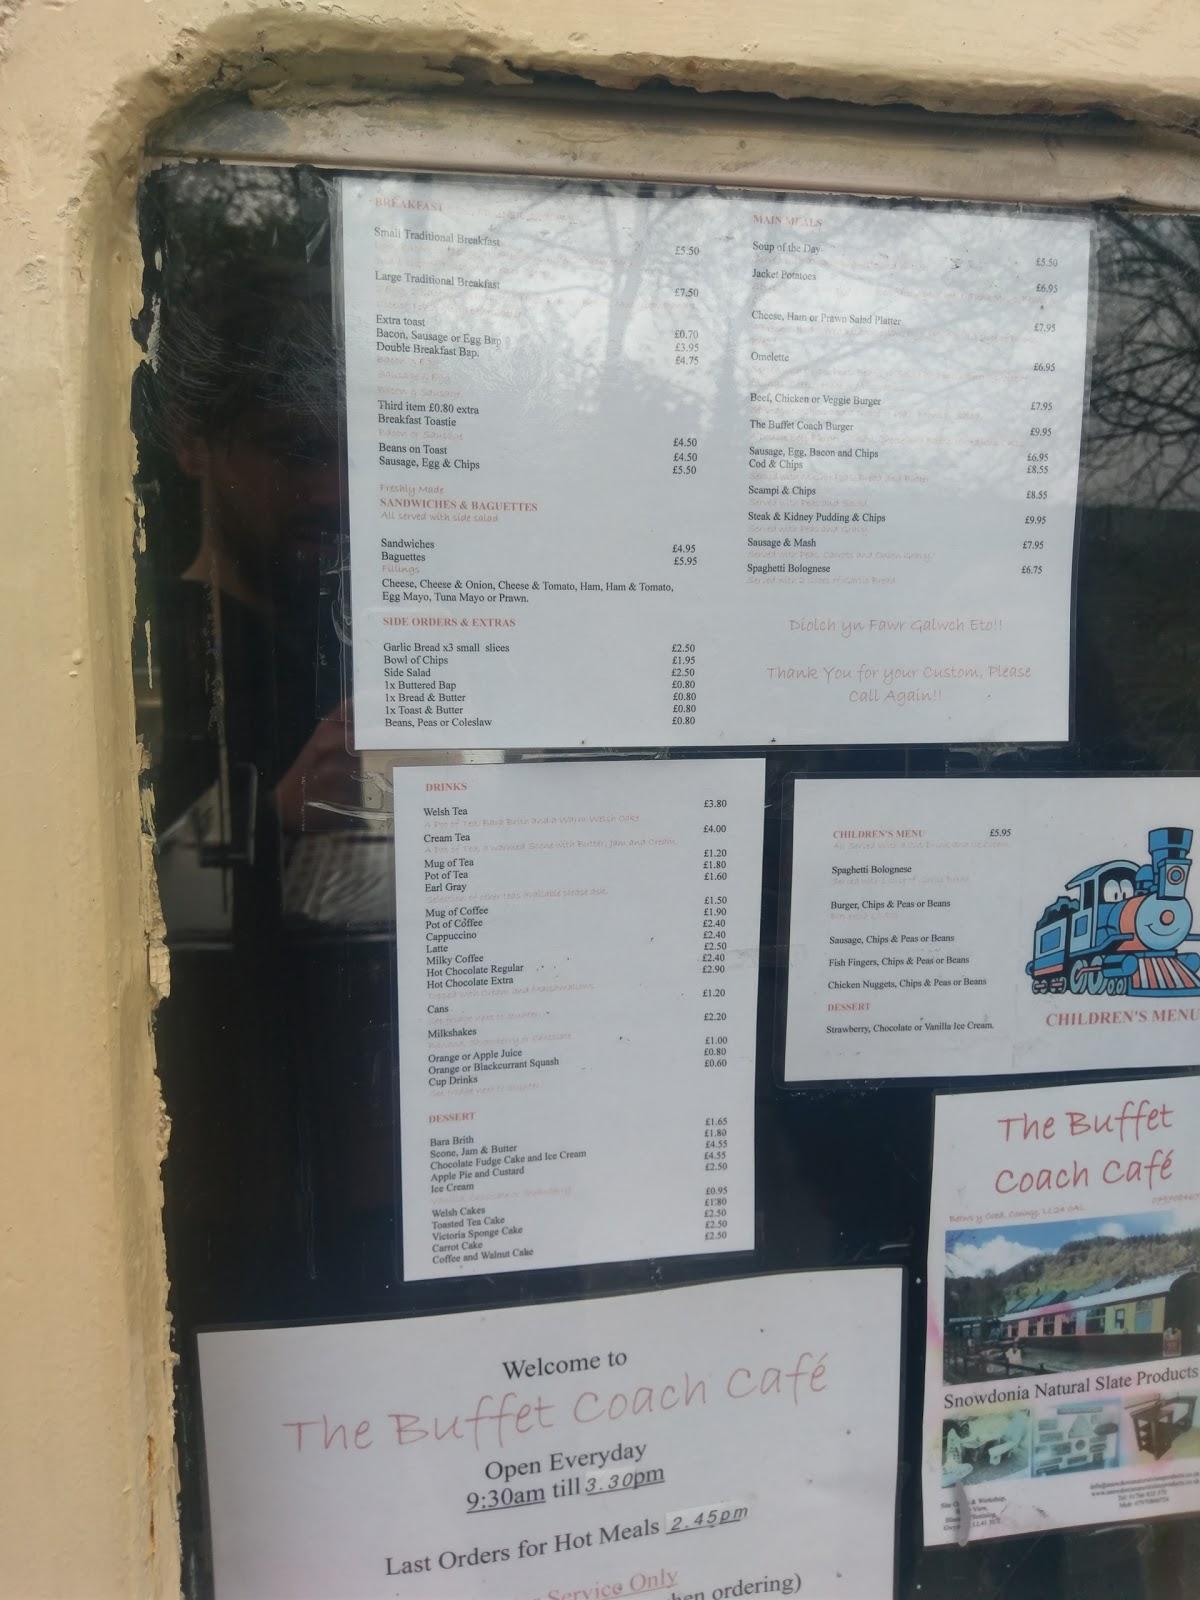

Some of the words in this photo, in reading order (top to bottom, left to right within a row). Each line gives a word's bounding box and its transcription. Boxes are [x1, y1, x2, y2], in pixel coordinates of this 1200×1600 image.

[752, 214, 783, 226] MAIN
[374, 226, 401, 239] Small
[404, 229, 455, 243] Traditional
[457, 233, 501, 247] Breakfast
[674, 245, 700, 257] £5.50
[751, 268, 779, 280] Jacket
[781, 270, 817, 281] Potatoes
[1035, 283, 1059, 294] £6.95
[751, 351, 790, 363] Omelette
[1033, 362, 1056, 373] £6.95
[377, 400, 403, 412] Third
[405, 402, 427, 414] item
[429, 402, 454, 414] £0.80
[456, 406, 479, 415] extra
[378, 414, 422, 426] Breakfast
[423, 416, 457, 427] Toastie
[750, 420, 767, 430] The
[768, 420, 795, 430] Buffet
[797, 420, 824, 431] Coach
[825, 421, 854, 432] Burger
[1029, 427, 1052, 438] £9.95
[673, 437, 698, 448] £4.50
[380, 498, 457, 512] SANDWICHES
[459, 500, 468, 511] &
[471, 500, 538, 512] BAGUETTES
[380, 511, 395, 521] All
[397, 512, 427, 521] served
[429, 512, 450, 522] with
[452, 513, 471, 523] side
[474, 513, 498, 523] salad
[748, 511, 771, 522] Steak
[772, 512, 782, 522] &
[783, 512, 814, 525] Kidney
[815, 512, 849, 525] Pudding
[851, 513, 860, 523] &
[862, 512, 886, 525] Chips
[1024, 515, 1047, 526] £9.95
[380, 538, 435, 550] Sandwiches
[672, 544, 696, 554] £4.95
[381, 551, 426, 563] Baguettes
[674, 557, 698, 567] £5.95
[382, 565, 420, 576] Fillings
[747, 563, 786, 576] Spaghetti
[788, 563, 831, 575] Bolognese
[1021, 565, 1043, 575] £6.75
[383, 617, 409, 627] SIDE
[411, 617, 458, 627] ORDERS
[460, 617, 469, 627] &
[471, 617, 516, 628] EXTRAS
[789, 619, 836, 632] Diolch
[841, 622, 865, 638] yn
[869, 620, 905, 632] Fawr
[910, 619, 965, 633] Galwch
[970, 618, 1003, 632] Eto!!
[383, 642, 412, 653] Garlic
[413, 642, 441, 653] Bread
[443, 643, 455, 653] x3
[456, 642, 480, 653] small
[485, 643, 510, 653] slices
[671, 644, 696, 653] £2.50
[383, 667, 405, 678] Side
[406, 667, 431, 678] Salad
[671, 668, 696, 678] £2.50
[766, 666, 819, 680] Thank
[823, 666, 852, 682] You
[858, 663, 878, 682] for
[883, 667, 916, 685] your
[923, 666, 984, 681] Custom,
[988, 665, 1032, 679] Please
[848, 689, 880, 704] Call
[884, 689, 943, 707] Again!!
[385, 718, 416, 729] Beans,
[417, 718, 438, 728] Peas
[451, 718, 493, 728] Coleslaw
[671, 716, 696, 726] £0.80
[425, 782, 468, 792] DRINKS
[703, 799, 727, 809] £3.80
[423, 807, 453, 817] Welsh
[453, 806, 468, 816] Tea
[833, 829, 894, 839] CHILDREN'S
[896, 828, 926, 838] MENU
[989, 827, 1012, 838] £5.95
[831, 864, 869, 876] Spaghetti
[870, 864, 912, 875] Bolognese
[704, 871, 728, 882] £1.60
[425, 882, 443, 893] Earl
[445, 882, 467, 894] Gray
[830, 899, 860, 911] Burger,
[861, 899, 885, 911] Chips
[887, 899, 894, 909] &
[896, 899, 914, 909] Peas
[916, 901, 926, 909] or
[927, 898, 951, 908] Beans
[425, 931, 477, 943] Cappuccino
[425, 944, 449, 954] Latte
[426, 955, 453, 967] Milky
[454, 953, 484, 965] Coffee
[426, 968, 444, 978] Hot
[445, 965, 489, 977] Chocolate
[490, 963, 524, 976] Regular
[702, 964, 725, 975] £2.90
[427, 1004, 449, 1015] Cans
[827, 1002, 870, 1012] DESSERT
[1045, 1010, 1149, 1028] CHILDREN'S
[1151, 1007, 1200, 1024] MENU
[427, 1027, 477, 1039] Milkshakes
[826, 1023, 871, 1035] Strawberry,
[873, 1022, 912, 1033] Chocolate
[914, 1023, 923, 1032] or
[924, 1021, 951, 1032] Vanilla
[953, 1021, 966, 1031] Ice
[967, 1020, 994, 1031] Cream.
[428, 1111, 477, 1124] DESSERT
[705, 1117, 728, 1127] £1.65
[997, 1112, 1056, 1143] The
[1066, 1100, 1175, 1143] Buffet
[430, 1137, 450, 1148] Bara
[452, 1135, 475, 1146] Brith
[995, 1160, 1089, 1195] Coach
[1102, 1148, 1174, 1191] Café
[705, 1186, 728, 1196] £0.95
[432, 1207, 458, 1219] Welsh
[460, 1205, 486, 1217] Cakes
[501, 1352, 602, 1382] Welcome
[606, 1349, 629, 1370] to
[944, 1387, 1031, 1410] Snowdonia
[1033, 1378, 1091, 1400] Natural
[1094, 1372, 1133, 1392] Slate
[1136, 1365, 1200, 1386] Products
[282, 1414, 374, 1454] The
[388, 1393, 556, 1453] Buffet
[573, 1375, 708, 1422] Coach
[726, 1351, 829, 1405] Café
[484, 1460, 542, 1483] Open
[549, 1443, 648, 1472] Everyday
[466, 1487, 547, 1514] 9:30am
[552, 1477, 581, 1499] till
[666, 1504, 749, 1535] 2.45pm
[384, 1555, 432, 1576] Last
[438, 1548, 511, 1570] Orders
[518, 1539, 548, 1559] for
[554, 1532, 593, 1553] Hot
[599, 1518, 661, 1545] Meals
[628, 1567, 680, 1593] Only
[711, 1572, 802, 1600] ordering)
